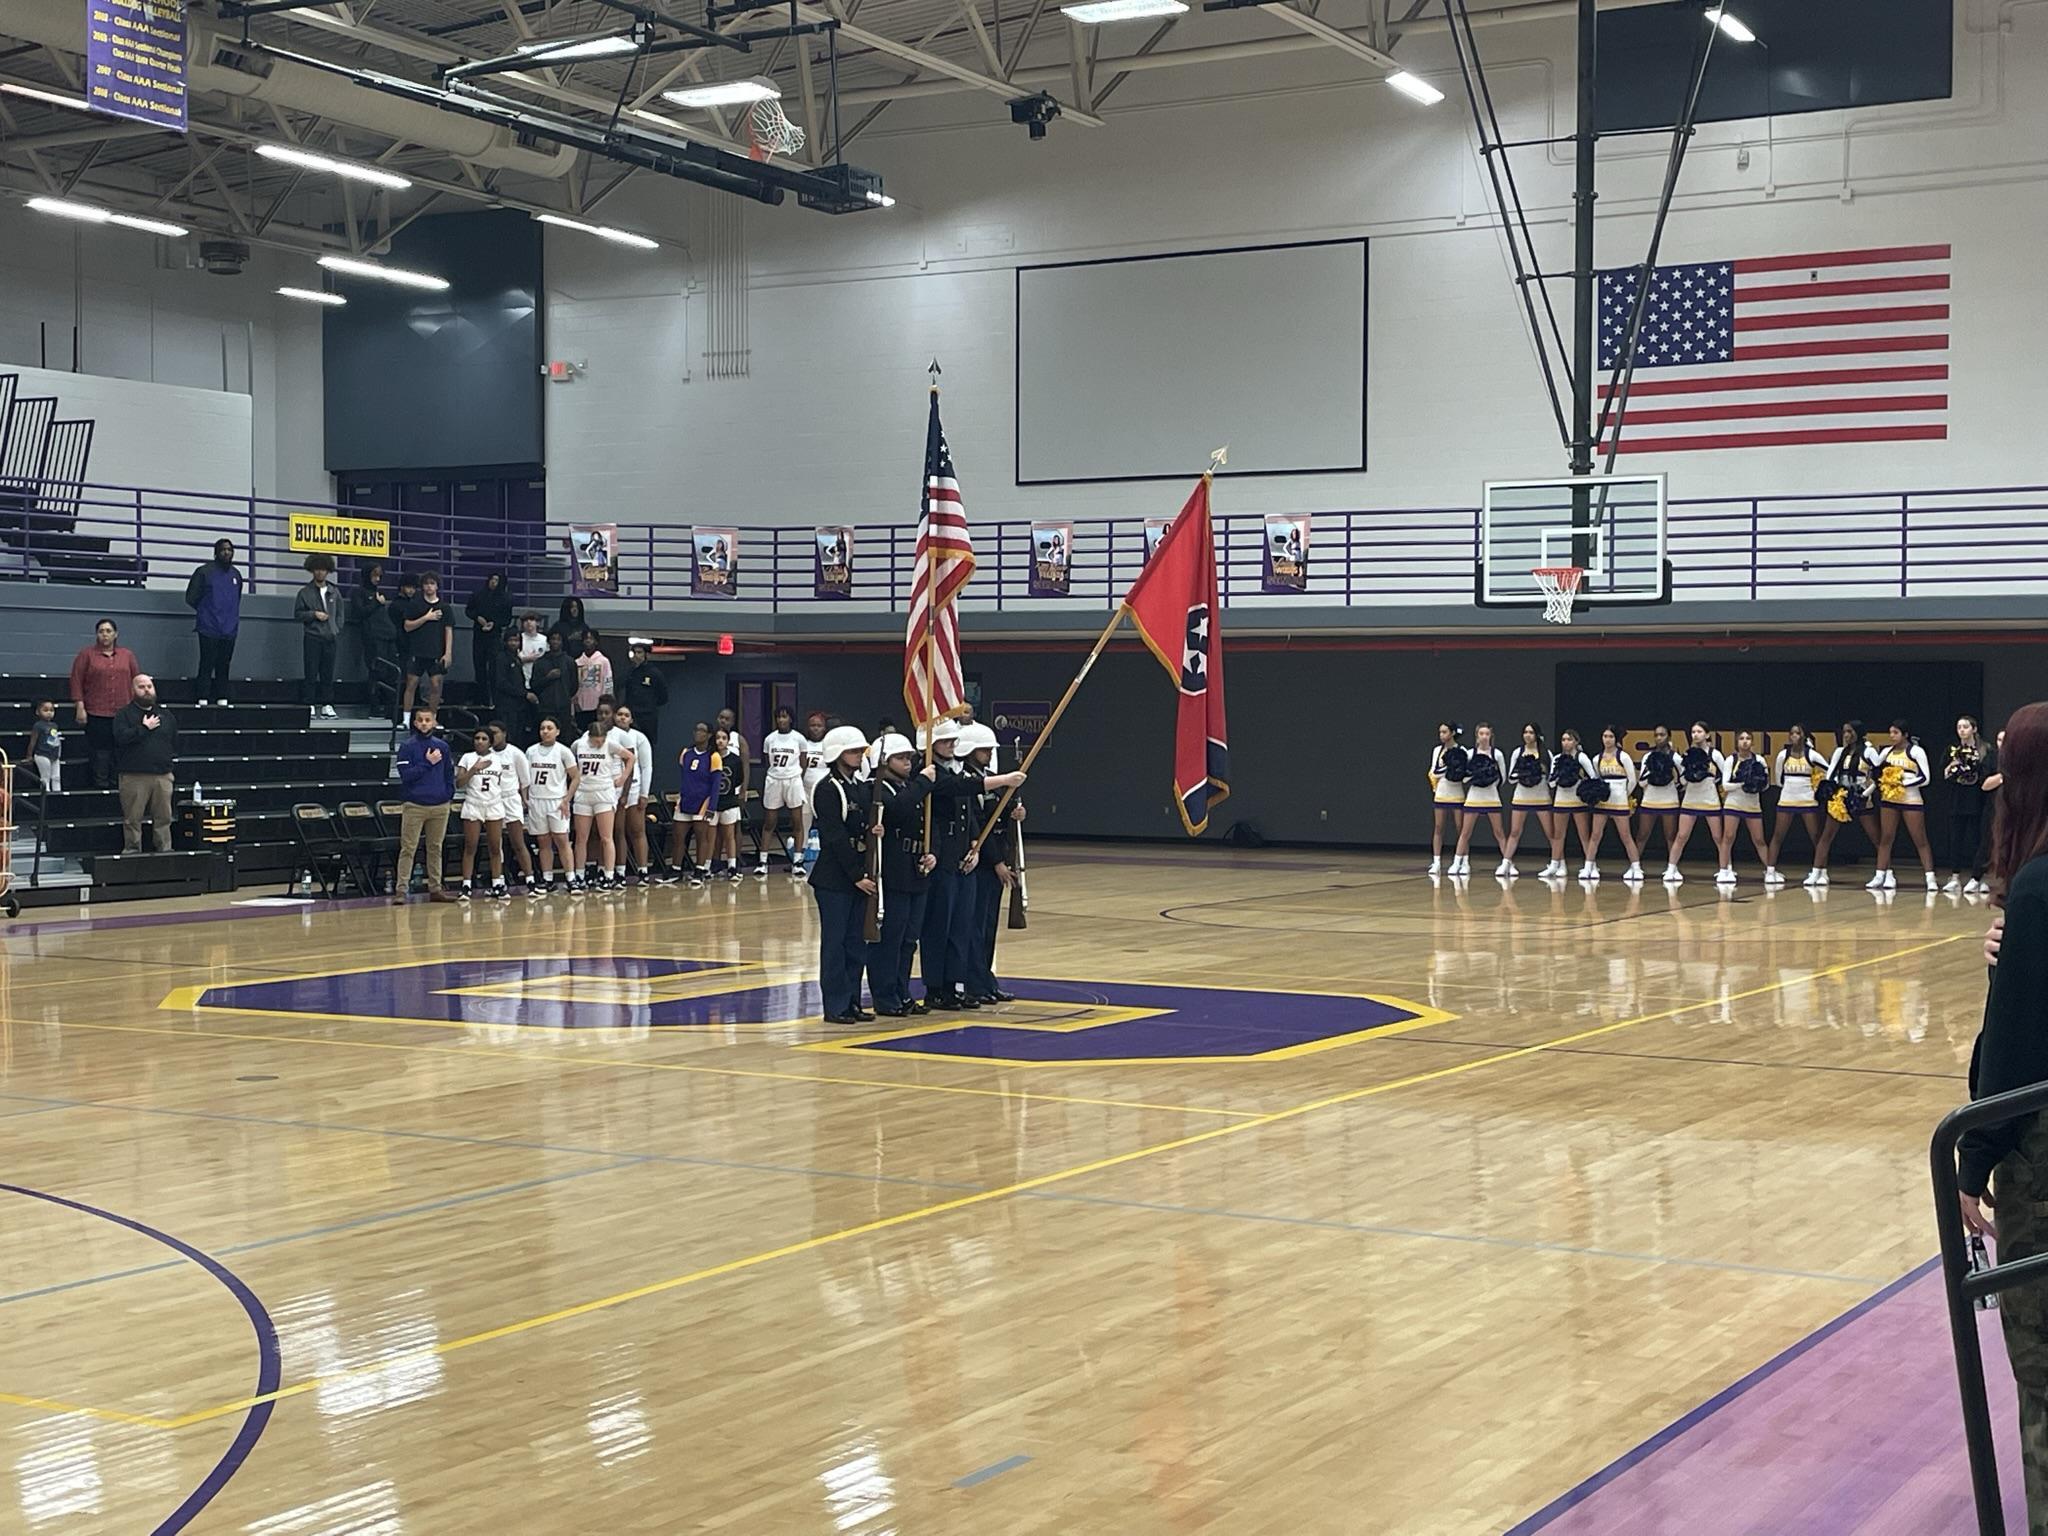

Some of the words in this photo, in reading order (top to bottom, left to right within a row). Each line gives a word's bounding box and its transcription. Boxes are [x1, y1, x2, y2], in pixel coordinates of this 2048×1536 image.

[132, 21, 149, 33] AAA
[133, 76, 151, 87] AAA
[152, 80, 184, 96] Sectional
[131, 97, 148, 109] AAA
[150, 101, 182, 117] Sectional
[295, 523, 351, 545] BULLDOG
[353, 527, 385, 548] FANS
[582, 761, 600, 776] 24
[773, 754, 789, 768] 50
[481, 777, 491, 792] 5
[534, 771, 549, 785] 15
